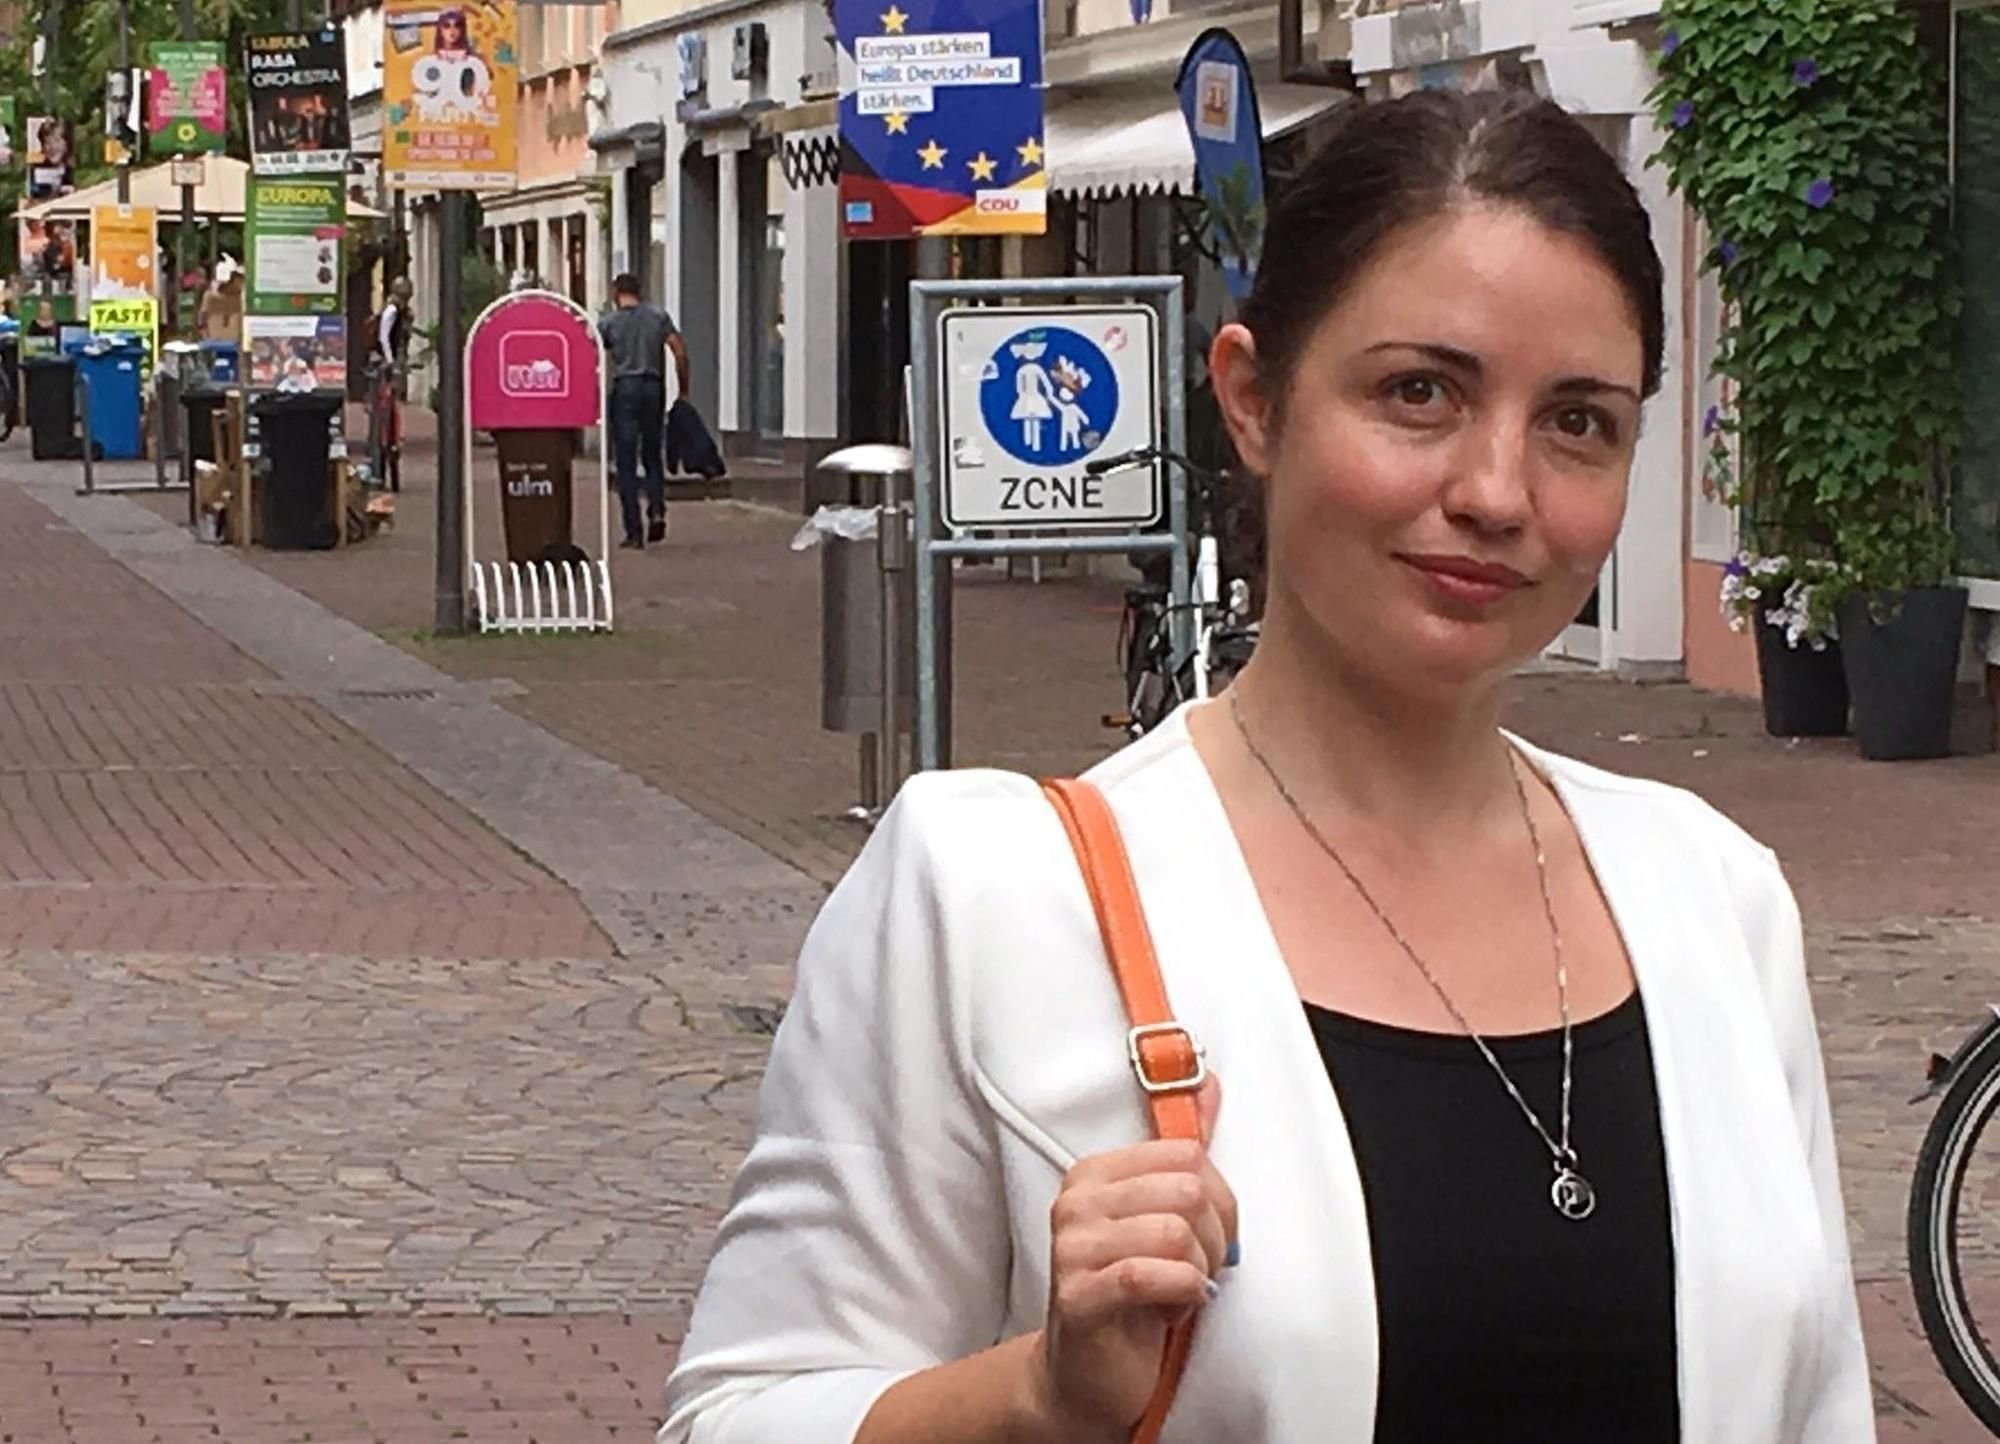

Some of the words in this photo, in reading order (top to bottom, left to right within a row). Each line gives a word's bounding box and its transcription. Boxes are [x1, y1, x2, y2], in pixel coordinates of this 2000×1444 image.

[861, 42, 916, 60] Europa
[921, 38, 984, 54] stärken
[907, 64, 1013, 82] Deutschland
[863, 93, 927, 109] stärken.
[979, 198, 1019, 212] CDU
[508, 475, 552, 496] ulm
[1000, 476, 1103, 509] ZONE
